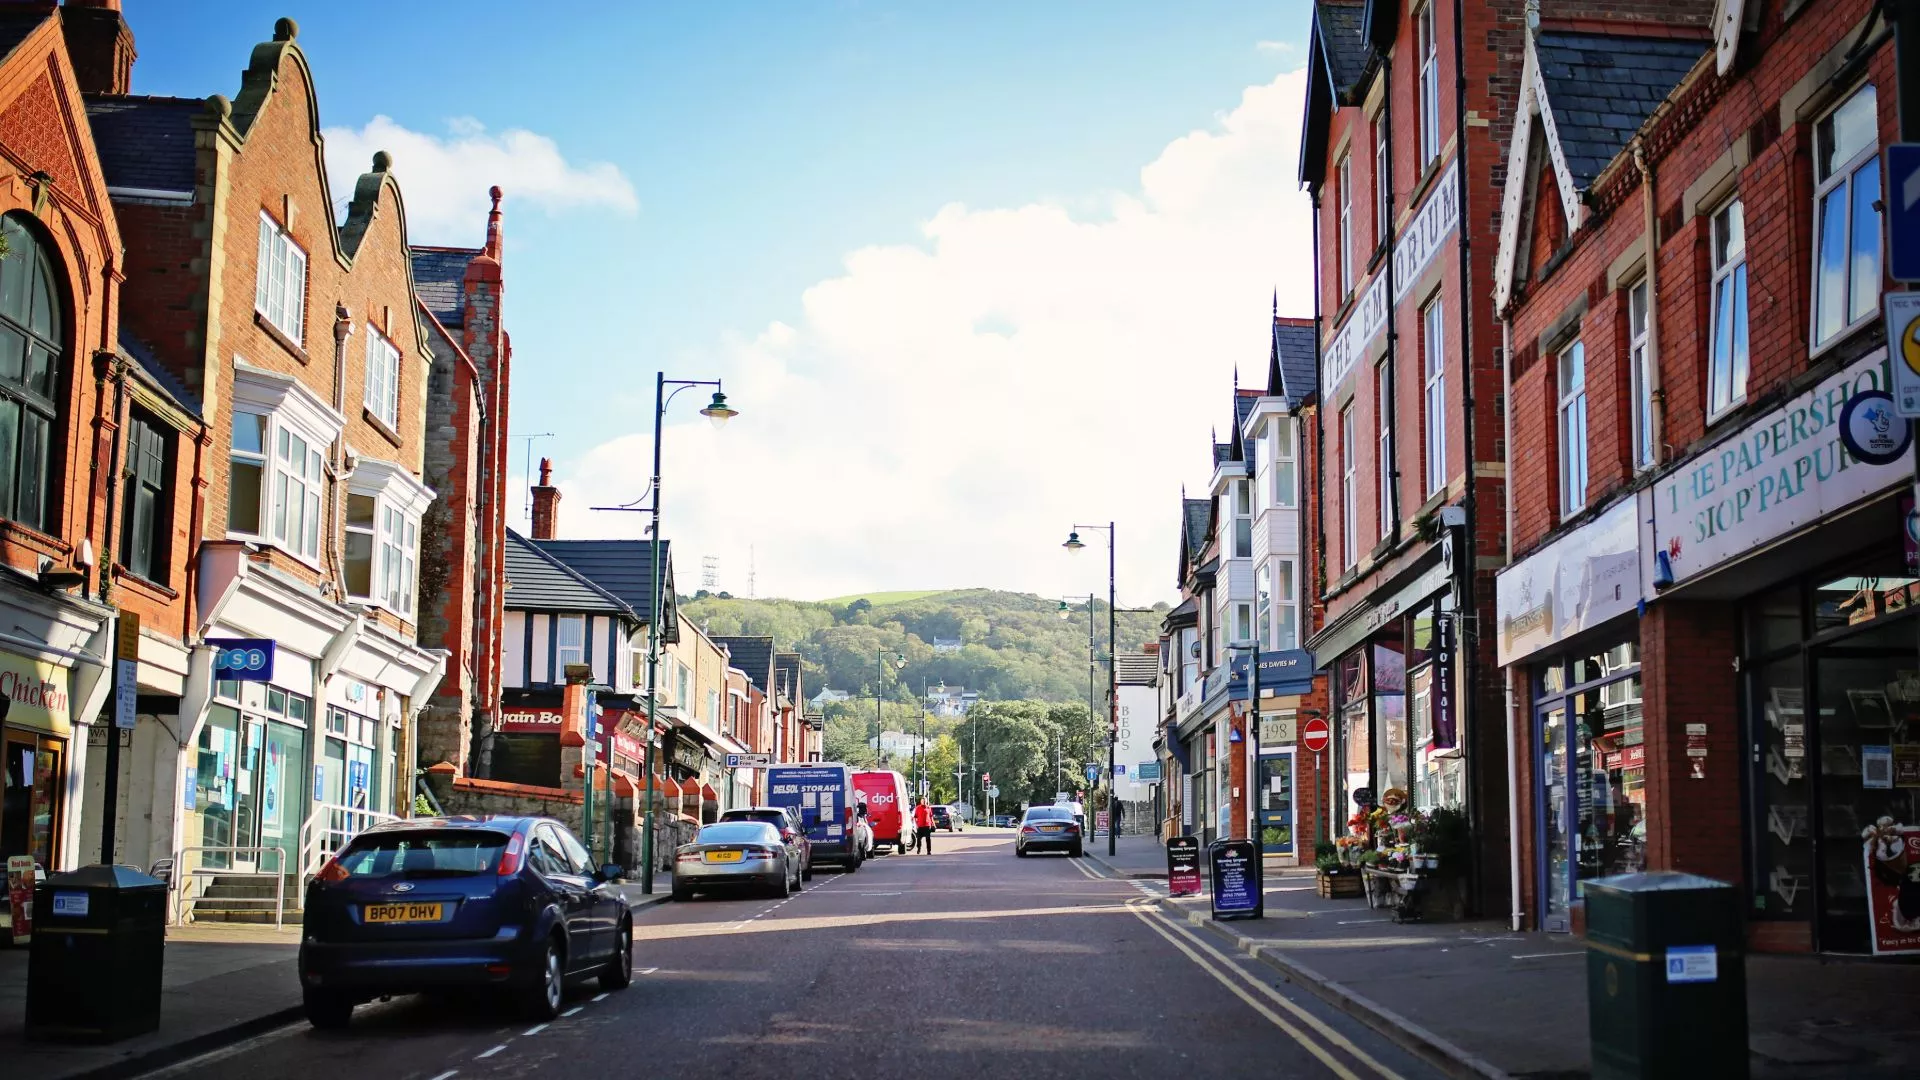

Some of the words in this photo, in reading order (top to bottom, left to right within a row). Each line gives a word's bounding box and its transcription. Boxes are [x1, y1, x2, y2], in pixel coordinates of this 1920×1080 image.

[1328, 326, 1351, 388] THE
[1363, 170, 1457, 340] EMORIUM
[1667, 462, 1715, 514] THE
[1695, 488, 1750, 544] SIOP
[217, 653, 260, 666] TSB
[0, 671, 67, 711] Chicken
[1121, 706, 1131, 751] BEDS
[1263, 722, 1288, 740] 198
[773, 784, 798, 794] DELSOL
[801, 784, 841, 792] STORAGE
[872, 792, 894, 805] dpd
[370, 906, 405, 920] BP07
[409, 906, 436, 918] OHV
